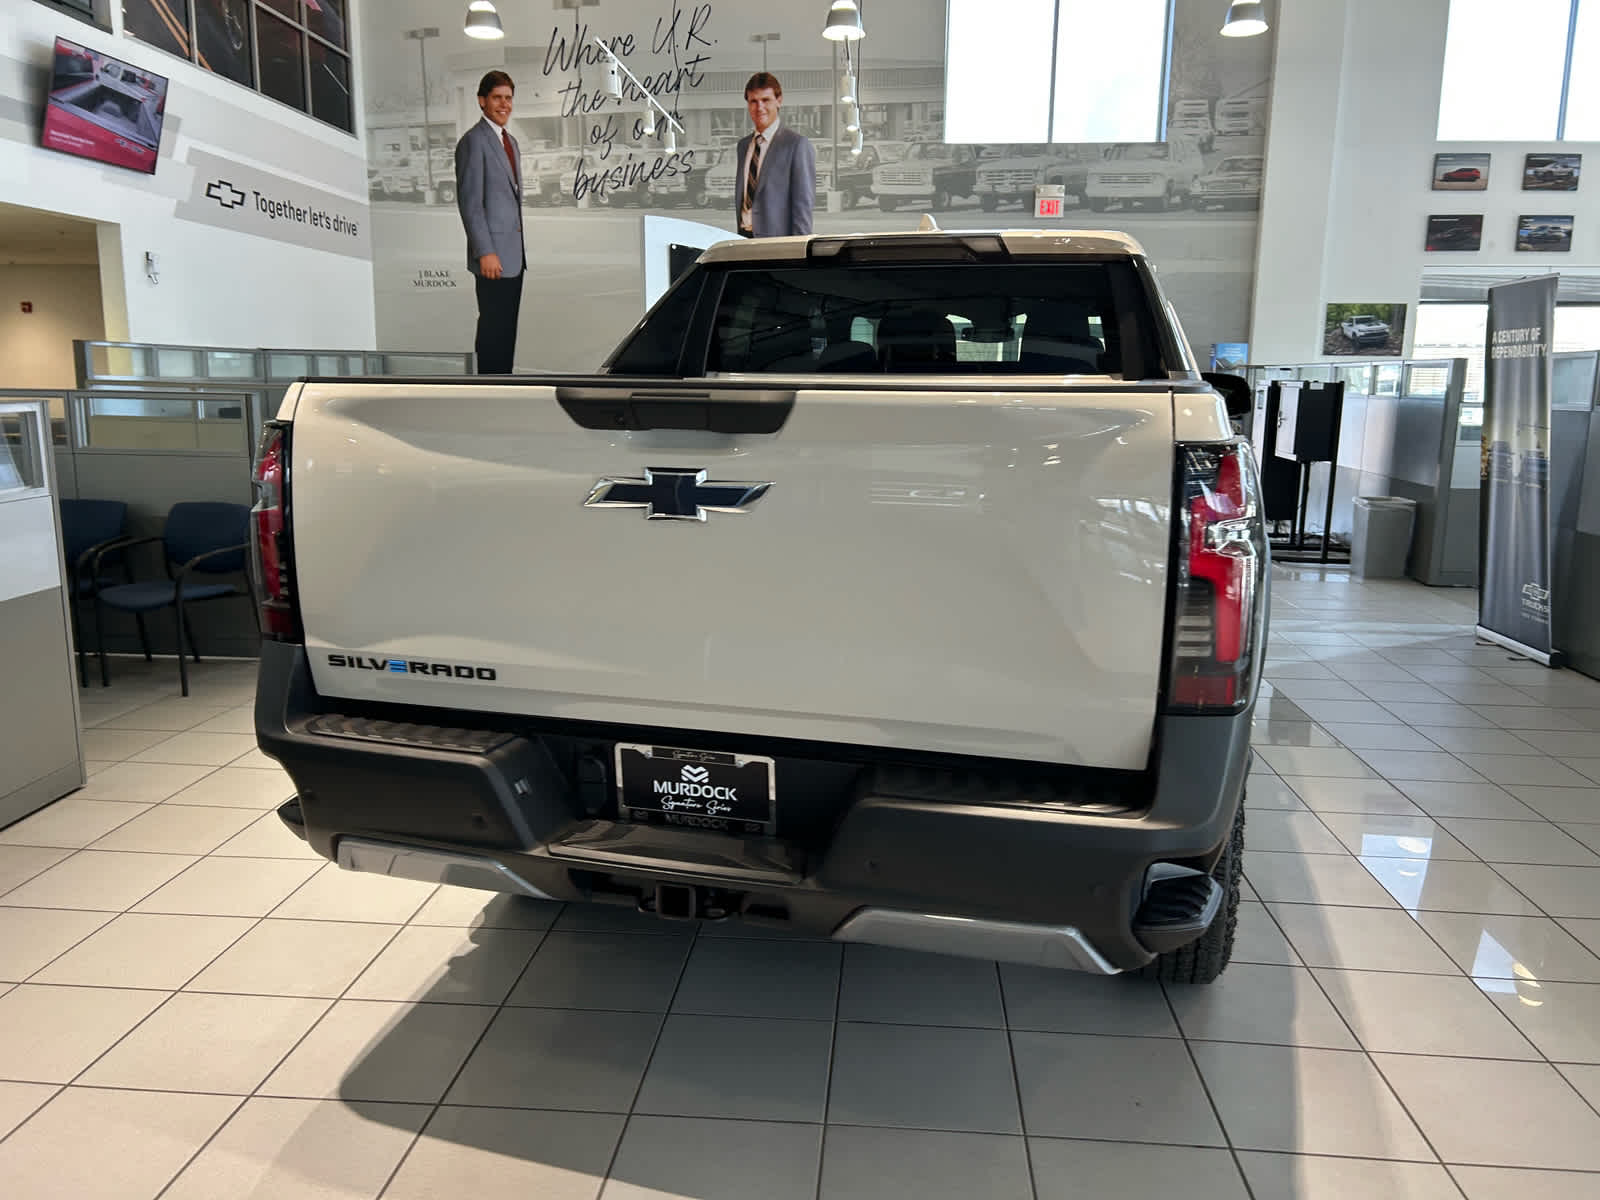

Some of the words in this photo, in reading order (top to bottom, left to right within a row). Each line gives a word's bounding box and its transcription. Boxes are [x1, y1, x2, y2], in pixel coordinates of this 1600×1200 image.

[558, 79, 607, 118] the
[617, 55, 712, 105] heart
[590, 115, 618, 160] of
[573, 150, 694, 200] business
[252, 190, 308, 224] Together
[308, 206, 331, 230] let's
[333, 214, 358, 236] drive
[1040, 199, 1060, 216] EXIT
[411, 279, 457, 288] MURDOCK
[1498, 327, 1530, 344] CENTURY
[1530, 327, 1541, 341] OF
[328, 654, 497, 681] SILVERADO
[653, 779, 738, 801] MURDOCK
